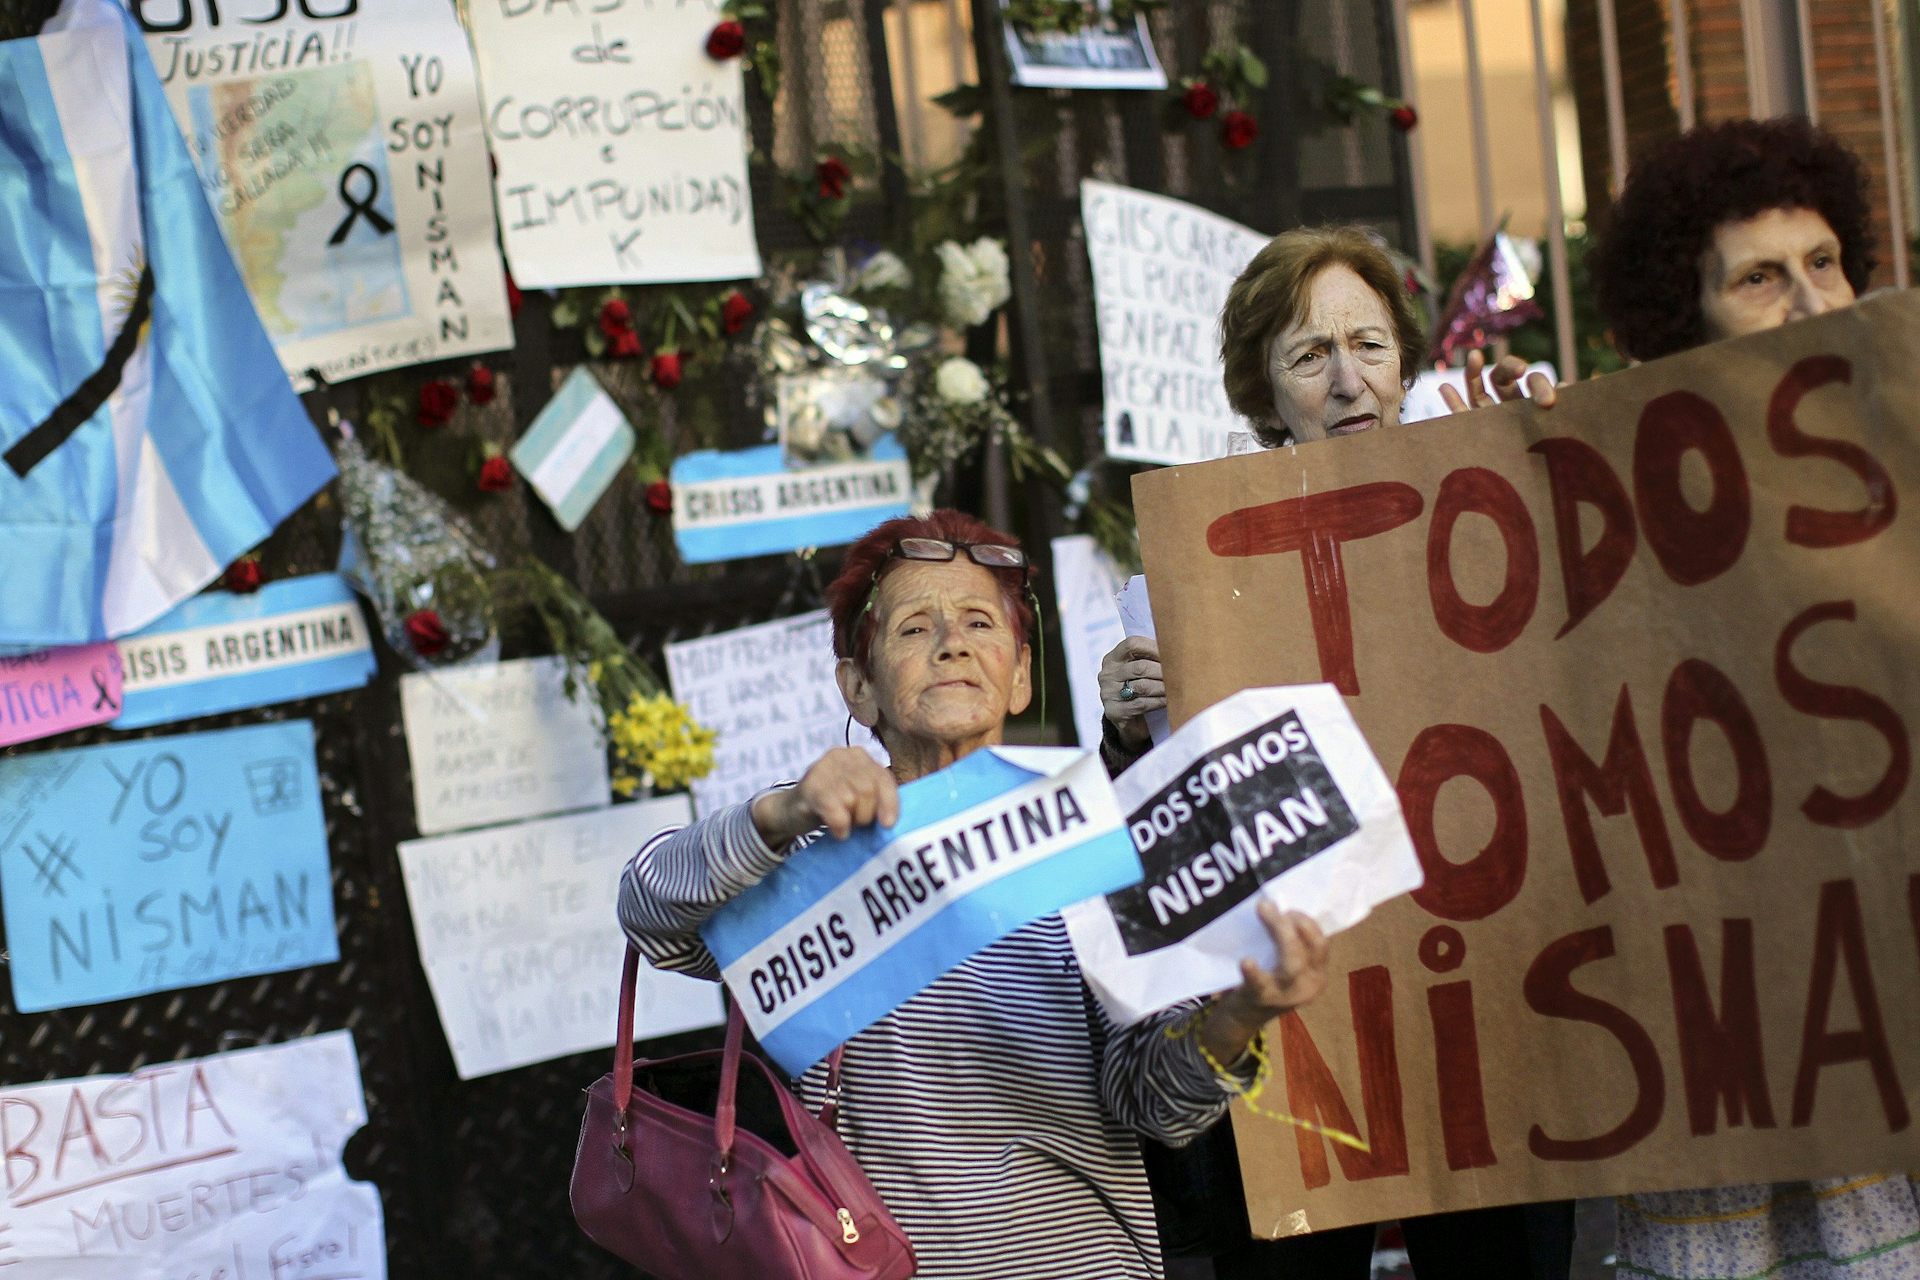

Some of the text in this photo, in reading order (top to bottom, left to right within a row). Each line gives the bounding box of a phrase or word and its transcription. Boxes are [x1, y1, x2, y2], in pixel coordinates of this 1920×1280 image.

[388, 112, 455, 152] SOY
[400, 53, 443, 98] YO
[416, 157, 468, 342] NISMAN
[608, 227, 644, 273] K
[684, 469, 898, 521] CRISIS ARGENTINA
[1206, 354, 1899, 697] TODOS
[0, 673, 83, 725] TICIA
[206, 615, 357, 667] ARGENTINA
[103, 751, 188, 825] YO
[1130, 720, 1309, 853] DOS SOMOS
[1397, 600, 1914, 922] OMOS
[138, 810, 234, 876] SOY
[750, 911, 855, 1016] CRISIS
[861, 784, 1088, 936] ARGENTINA
[1147, 787, 1329, 926] NISMAN
[48, 870, 313, 986] NISMAN
[1280, 873, 1920, 1190] NISMA
[0, 1063, 237, 1200] BASTA
